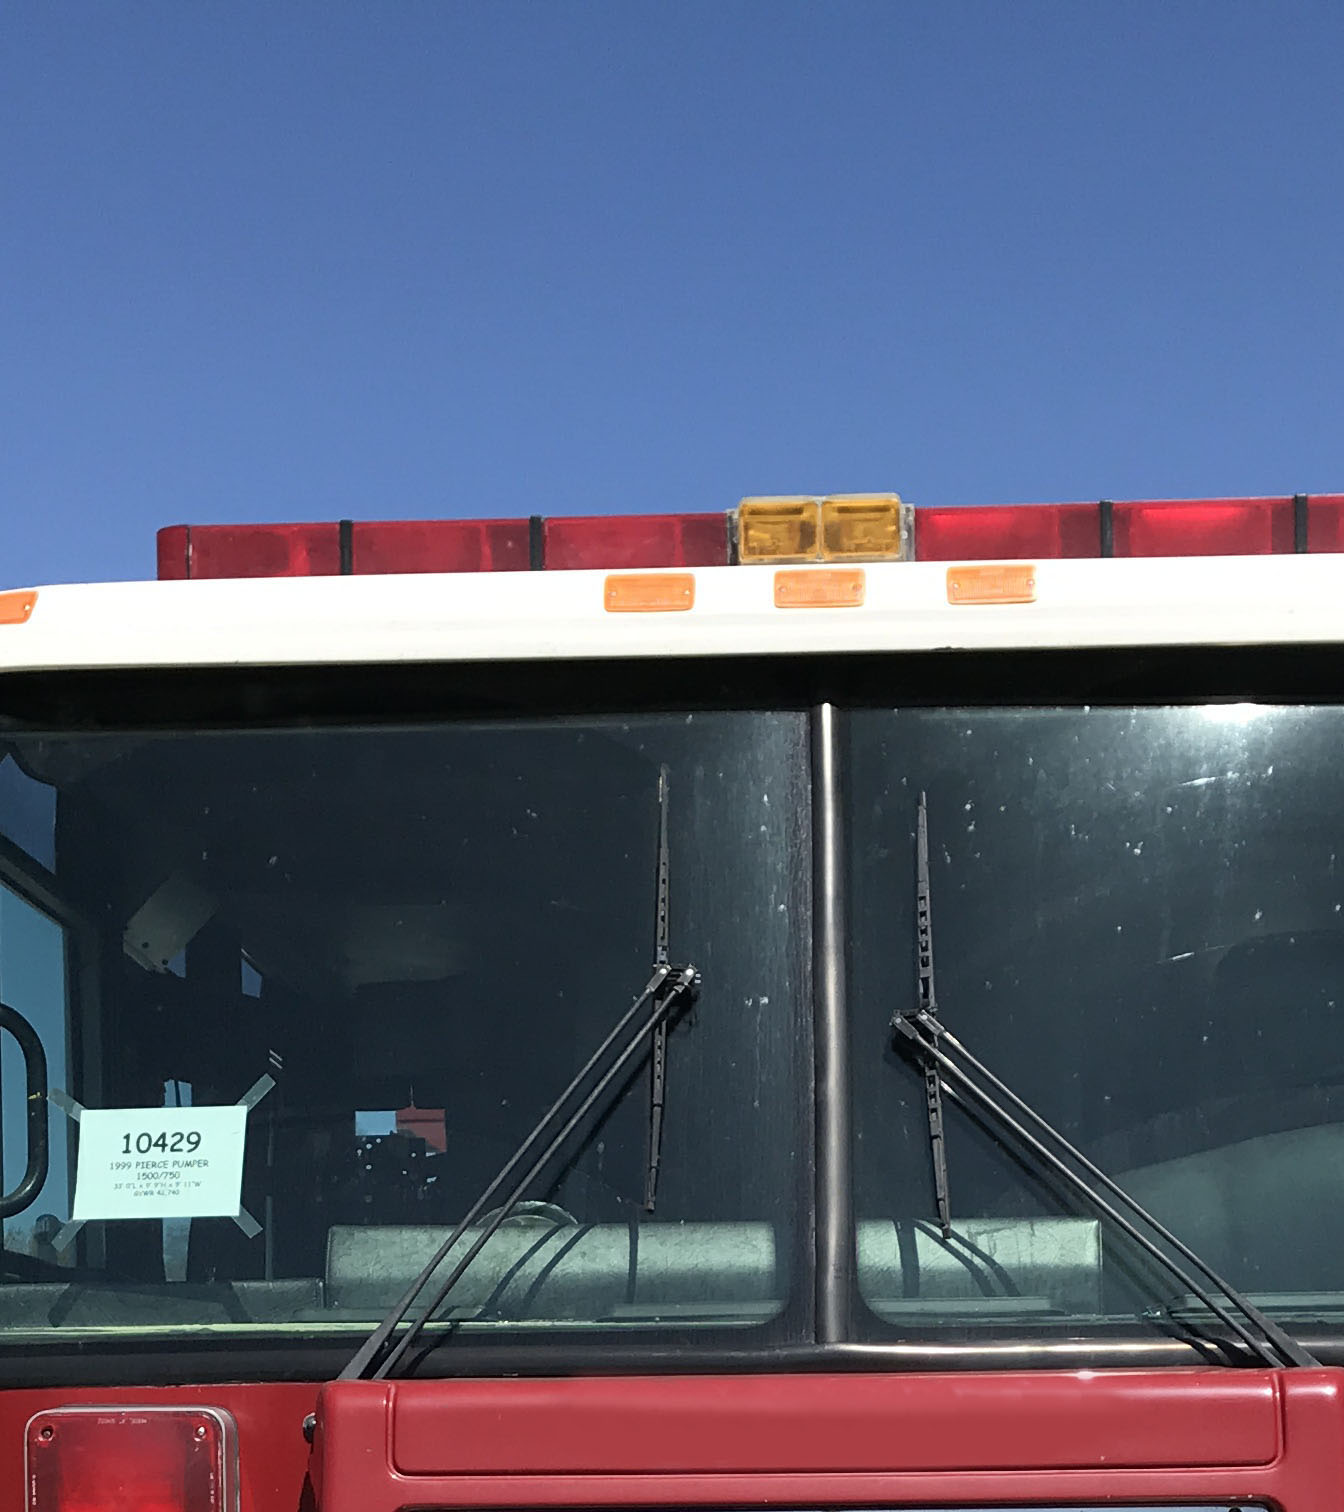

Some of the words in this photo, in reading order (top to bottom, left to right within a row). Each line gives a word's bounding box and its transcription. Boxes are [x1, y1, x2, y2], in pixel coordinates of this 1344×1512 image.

[121, 1131, 202, 1154] 10429
[110, 1161, 132, 1170] 1999
[135, 1160, 169, 1169] PIERCE
[172, 1159, 209, 1168] PUMPER
[137, 1171, 181, 1180] 1500/750
